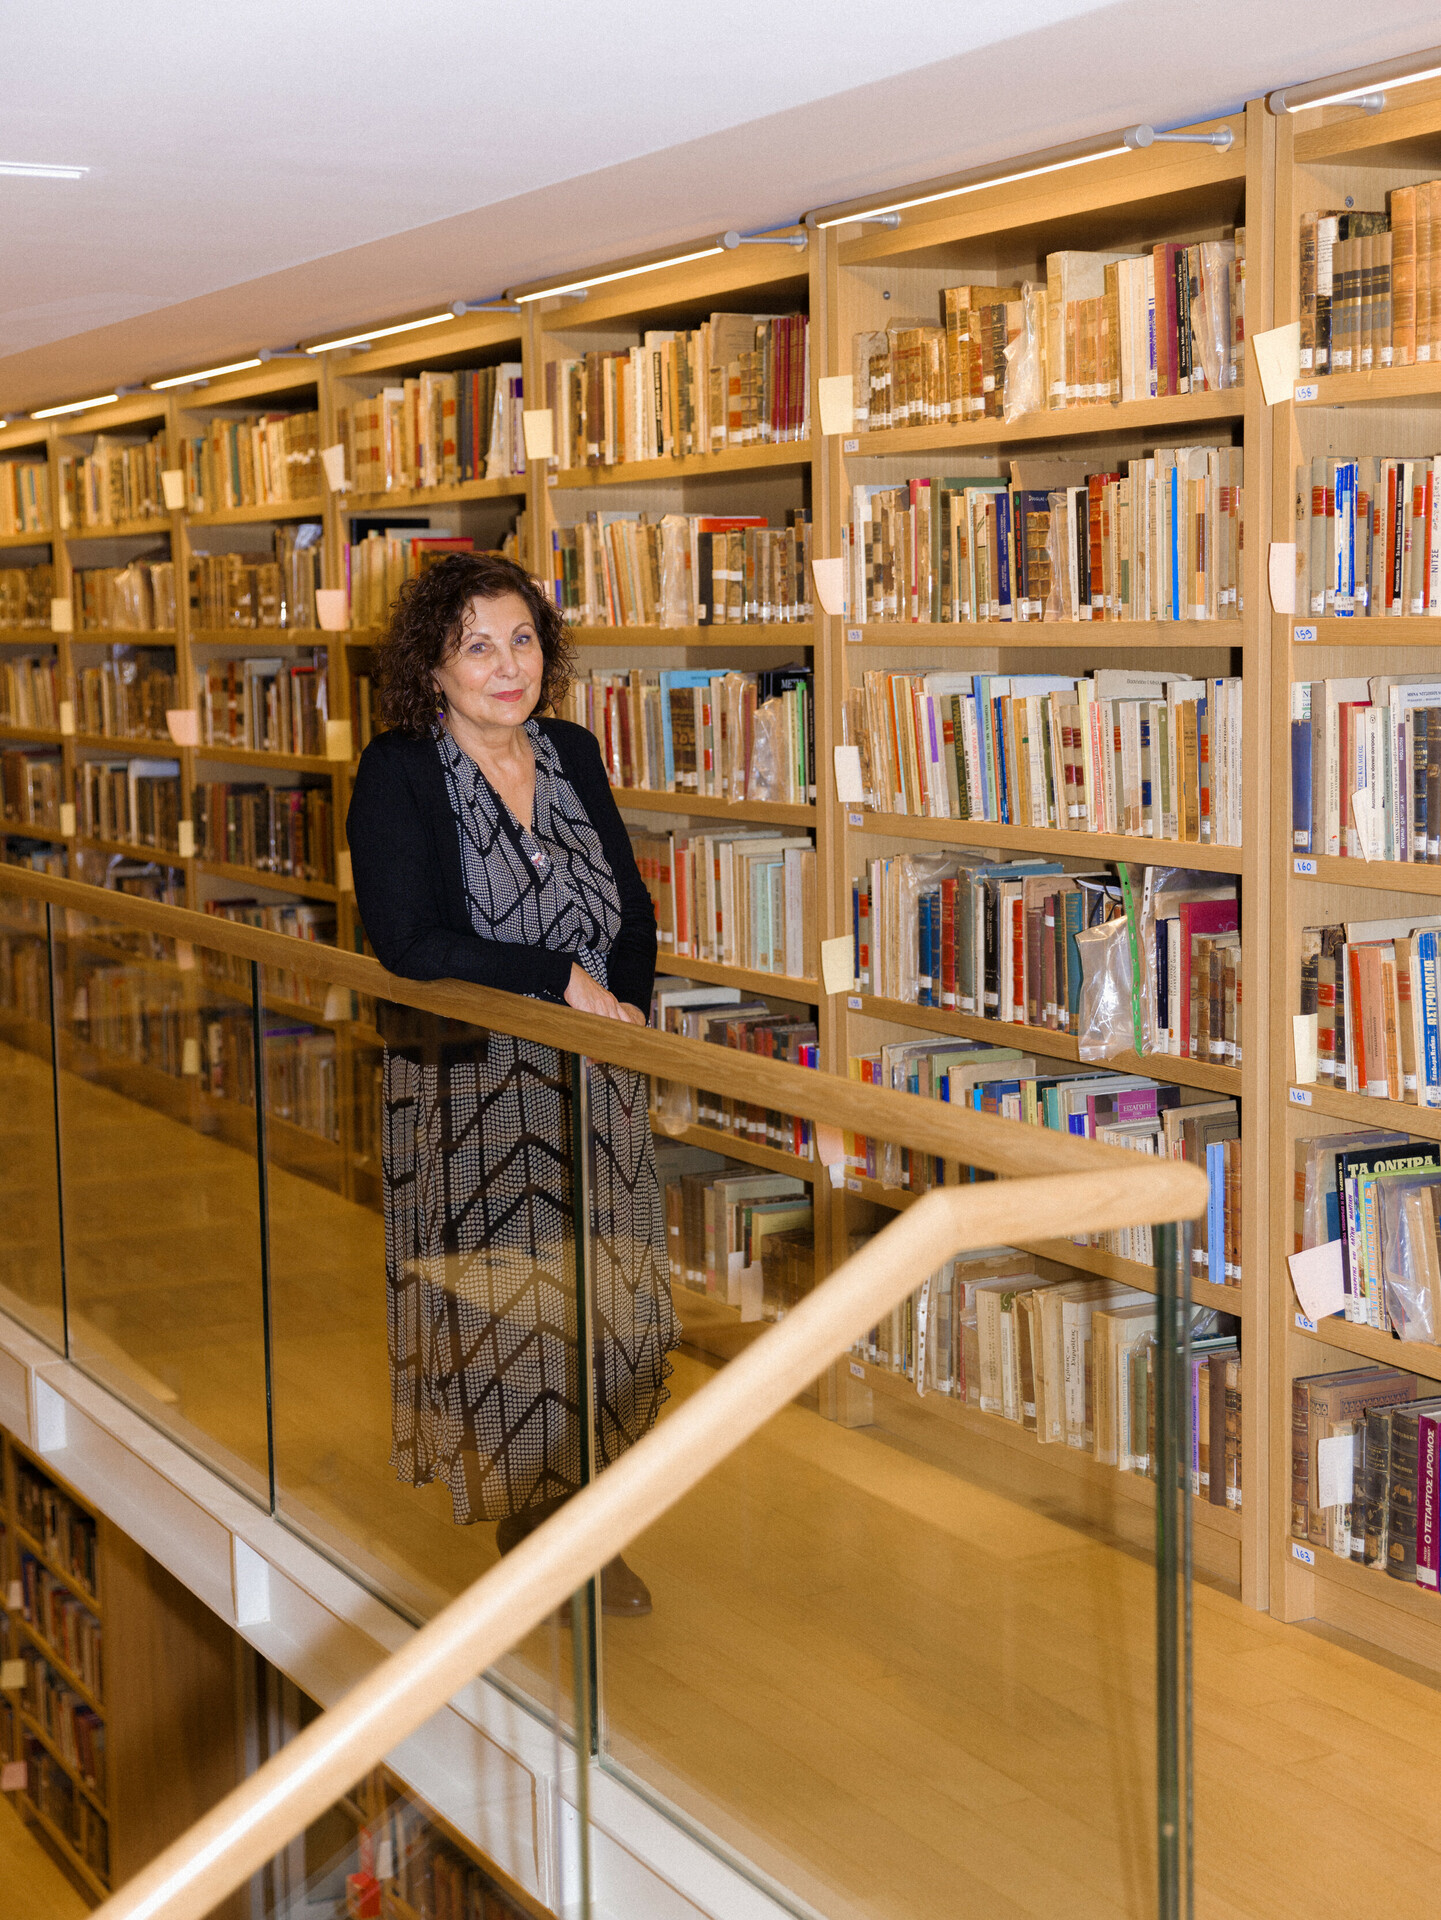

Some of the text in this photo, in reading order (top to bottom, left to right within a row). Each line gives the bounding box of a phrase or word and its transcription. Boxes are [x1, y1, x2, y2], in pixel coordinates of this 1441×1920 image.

[1297, 388, 1312, 398] 158
[1296, 629, 1312, 639] 159
[954, 703, 963, 757] ΔΙΑΣΤΗΜΑ
[1297, 862, 1312, 872] 160
[1425, 960, 1437, 1025] ΑΣΤΡΟΛΟΓΙΑ
[1292, 1091, 1305, 1101] 161
[1123, 1103, 1152, 1112] ΕΙΣΑΓΩΓΗ
[1347, 1156, 1434, 1178] ΤΑ ΟΝΕΙΡΑ
[1425, 1478, 1433, 1533] ΤΕΤΑΡΤΟΣ
[1425, 1534, 1432, 1544] Ο
[1296, 1548, 1311, 1562] 163
